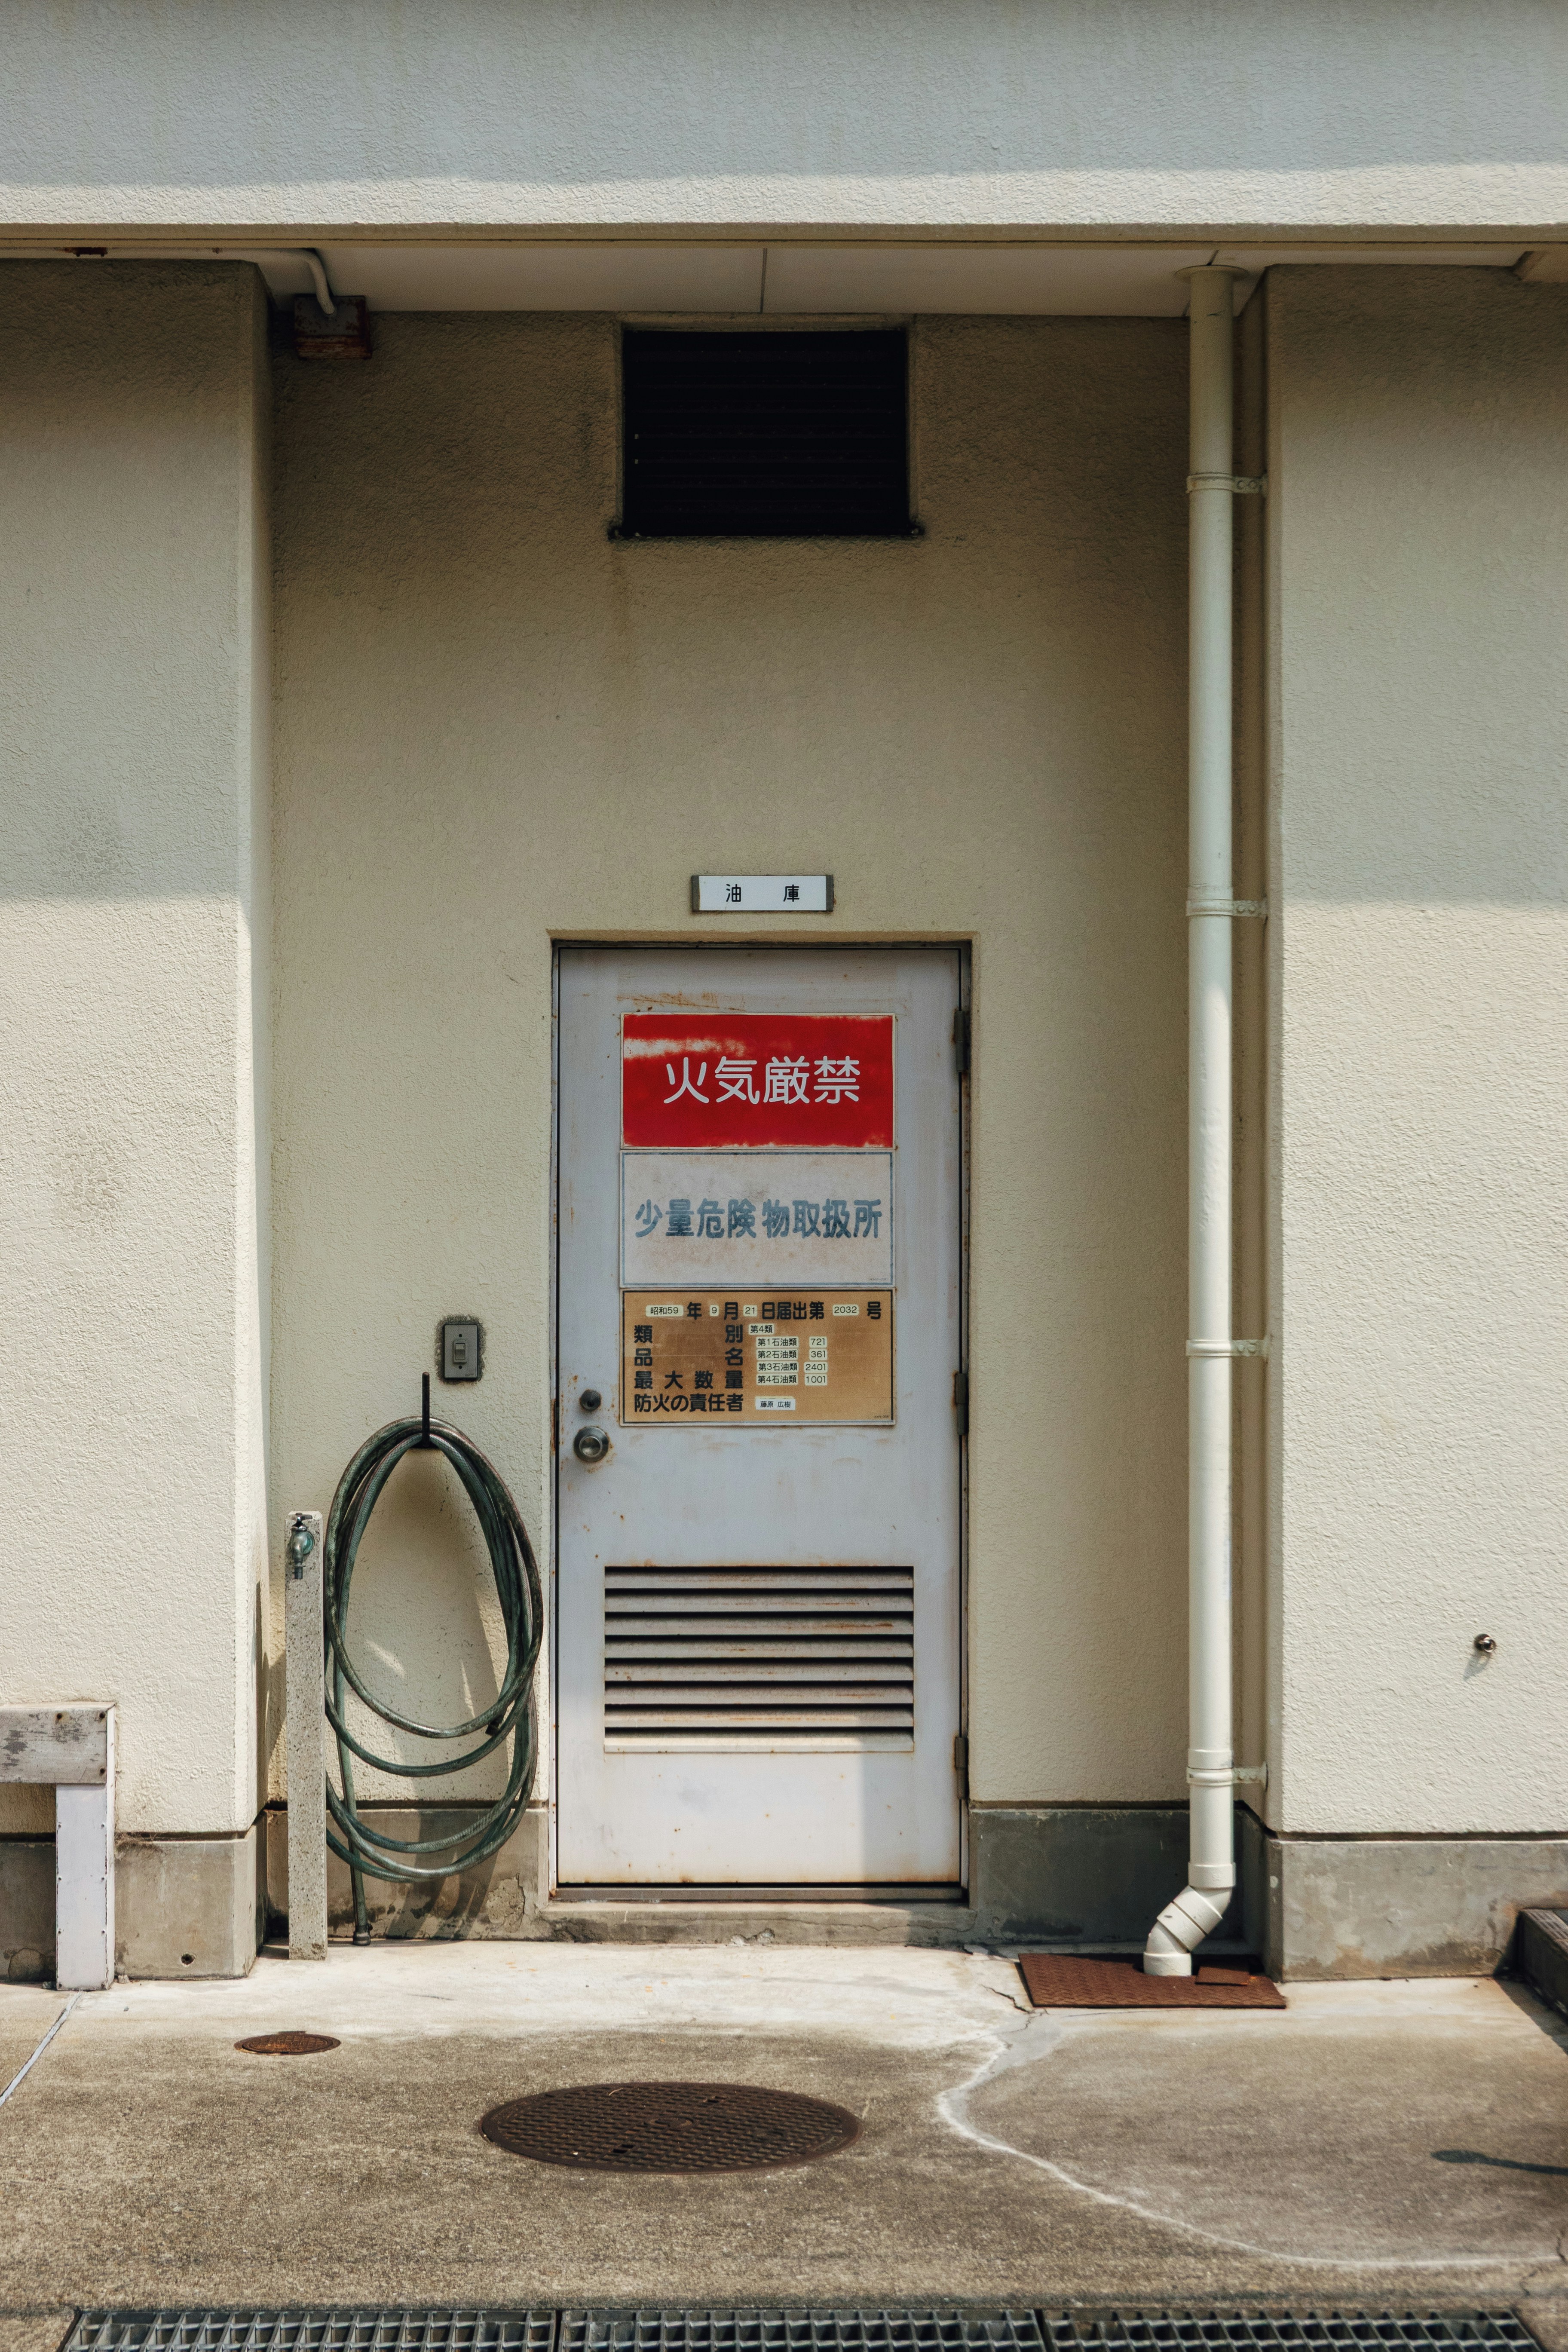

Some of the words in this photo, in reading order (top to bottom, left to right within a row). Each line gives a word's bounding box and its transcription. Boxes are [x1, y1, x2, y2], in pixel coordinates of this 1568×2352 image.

[726, 884, 800, 902] 油庫
[664, 1056, 860, 1104] 火気厳禁
[635, 1198, 882, 1239] 少量危険物取扱所
[750, 1325, 772, 1333] 第4類
[758, 1338, 797, 1346] 第1石油類
[757, 1350, 797, 1359] 第2石油類
[758, 1363, 797, 1371] 第3石油類
[634, 1370, 744, 1389] 最大数量
[757, 1375, 797, 1383] 第4石油類
[634, 1393, 744, 1412] 防火の責任者
